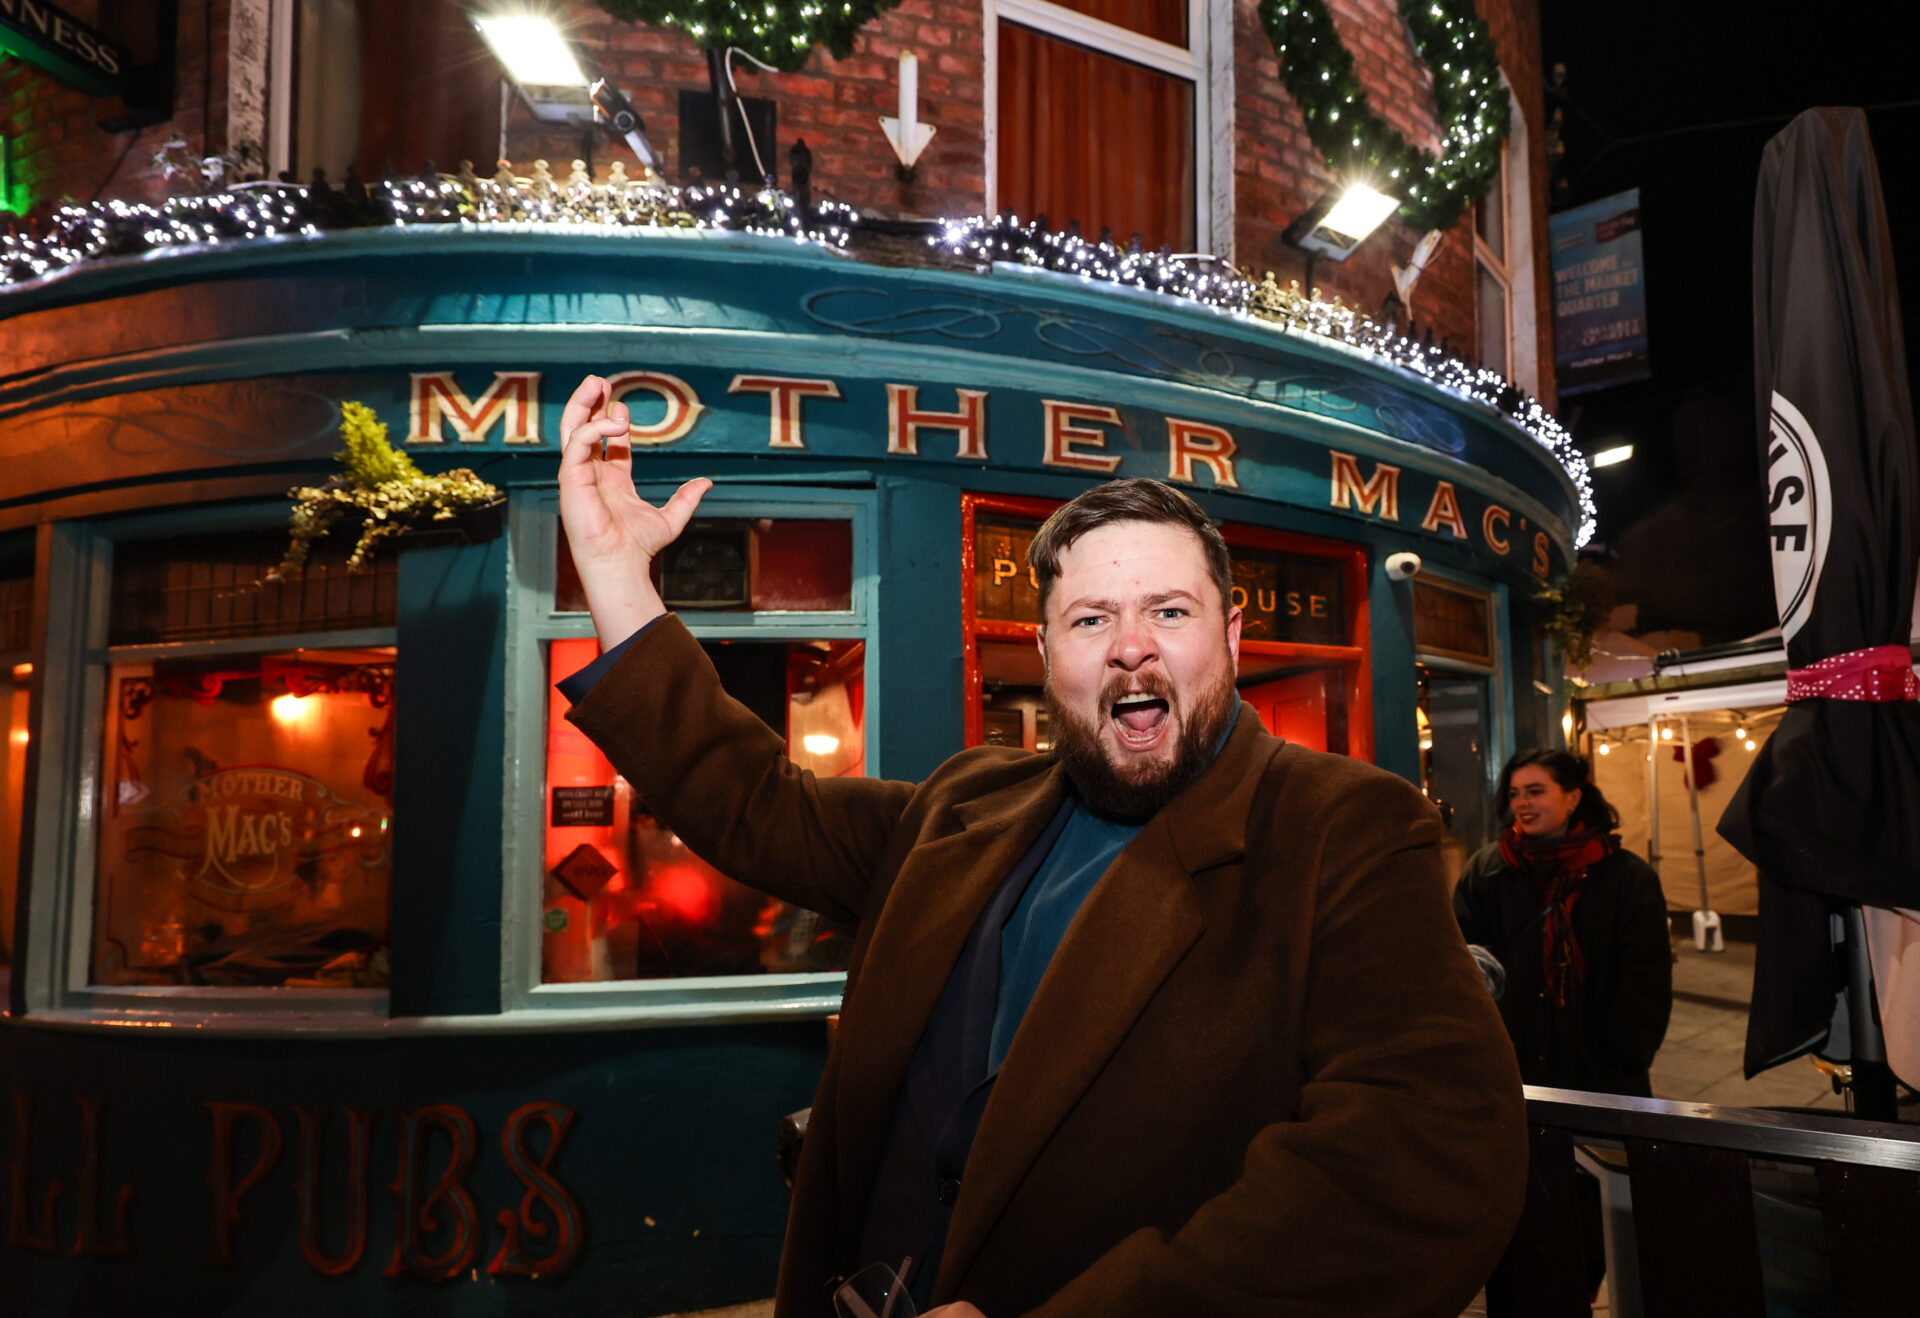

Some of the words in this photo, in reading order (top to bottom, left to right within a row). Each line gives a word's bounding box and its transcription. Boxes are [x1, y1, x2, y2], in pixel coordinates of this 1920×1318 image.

[1555, 254, 1618, 283] WELCOME
[1556, 280, 1581, 299] THE
[1584, 267, 1638, 293] MARKET
[1557, 290, 1619, 317] QUARTER
[404, 370, 1242, 489] MOTHER
[1329, 449, 1549, 578] MAC'S
[1229, 586, 1328, 618] OUSE
[195, 771, 304, 801] MOTHER
[204, 1100, 585, 1277] PUBS
